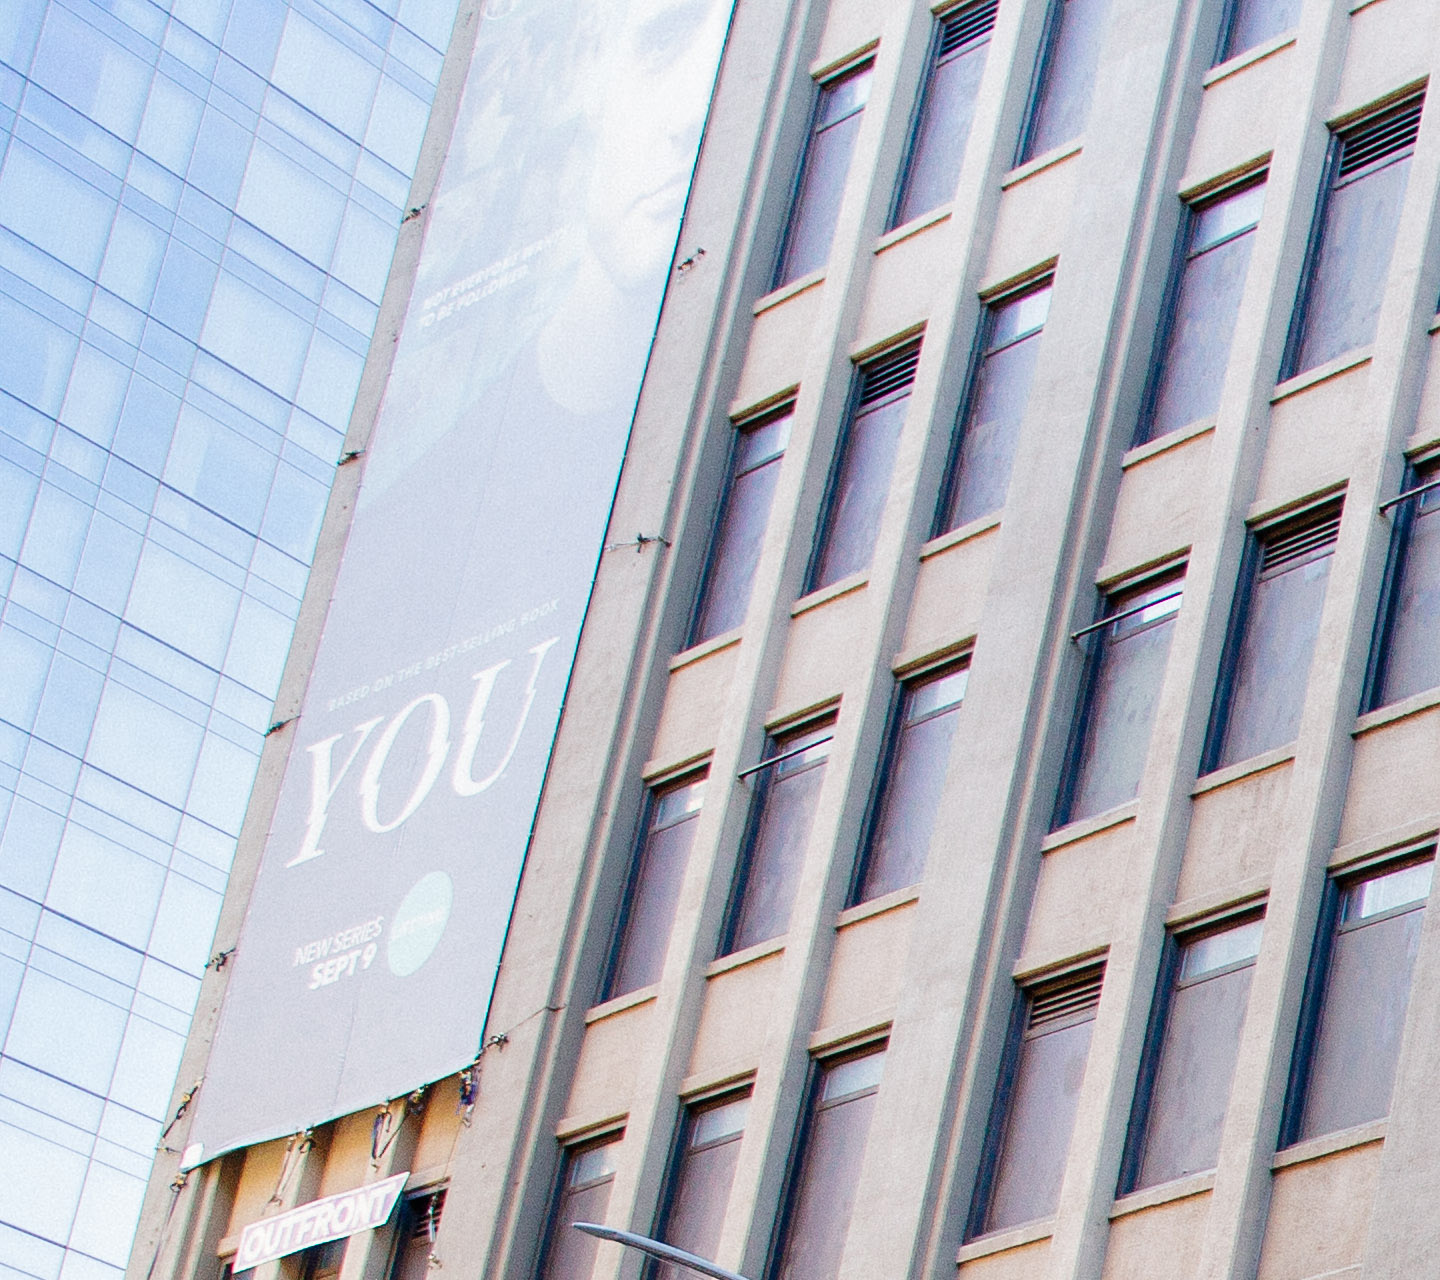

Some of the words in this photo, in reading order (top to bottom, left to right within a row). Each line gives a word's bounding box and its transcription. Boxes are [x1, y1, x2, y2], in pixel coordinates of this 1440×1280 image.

[329, 685, 370, 711] BASED
[373, 674, 393, 692] ON
[397, 662, 422, 683] THE
[521, 598, 561, 626] BOOK
[286, 636, 561, 868] YOU
[292, 937, 333, 967] NEW
[333, 916, 385, 953] SERIES
[309, 950, 362, 990] SEPT
[361, 943, 378, 969] 9
[241, 1181, 398, 1262] OUTFRONT
